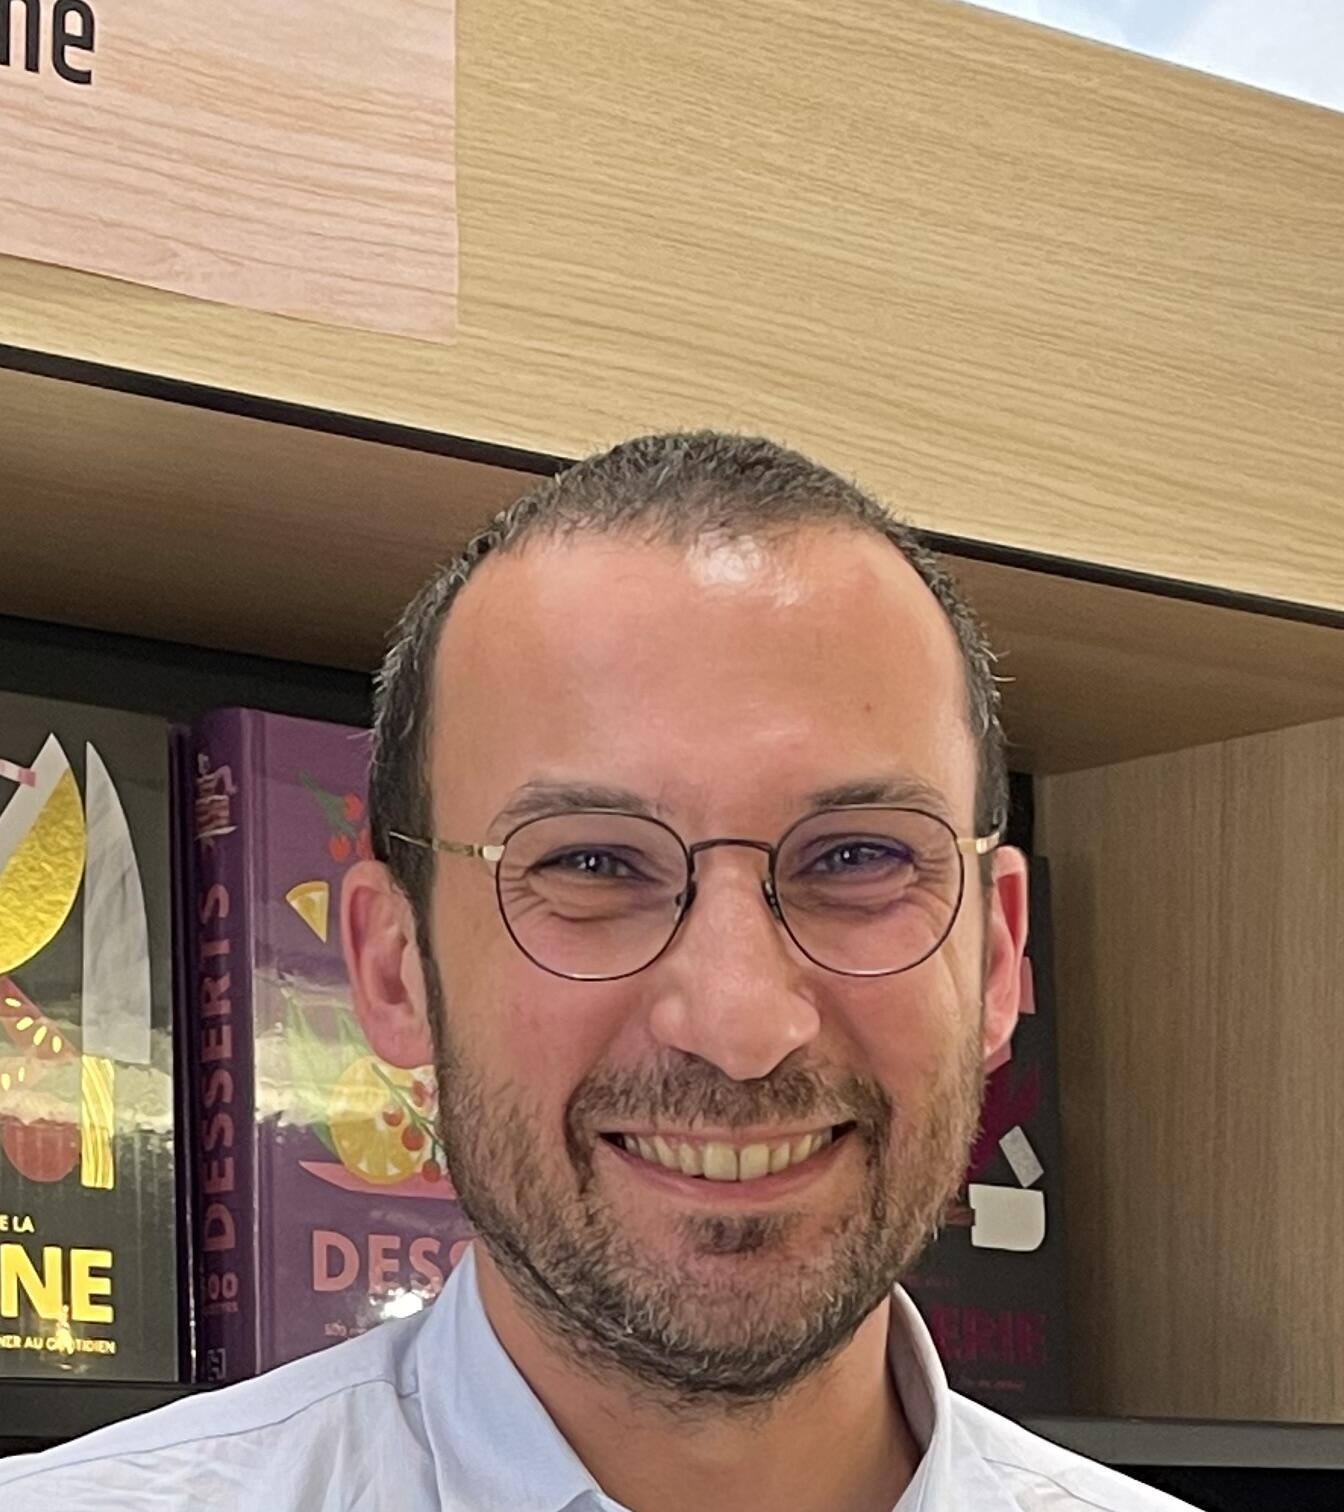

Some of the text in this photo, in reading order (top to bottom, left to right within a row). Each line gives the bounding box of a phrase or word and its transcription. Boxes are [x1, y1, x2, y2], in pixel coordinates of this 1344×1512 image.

[199, 882, 238, 1253] DESSERTS
[13, 1215, 35, 1233] LA
[23, 1336, 44, 1351] AU
[45, 1337, 117, 1355] QTIDIEN
